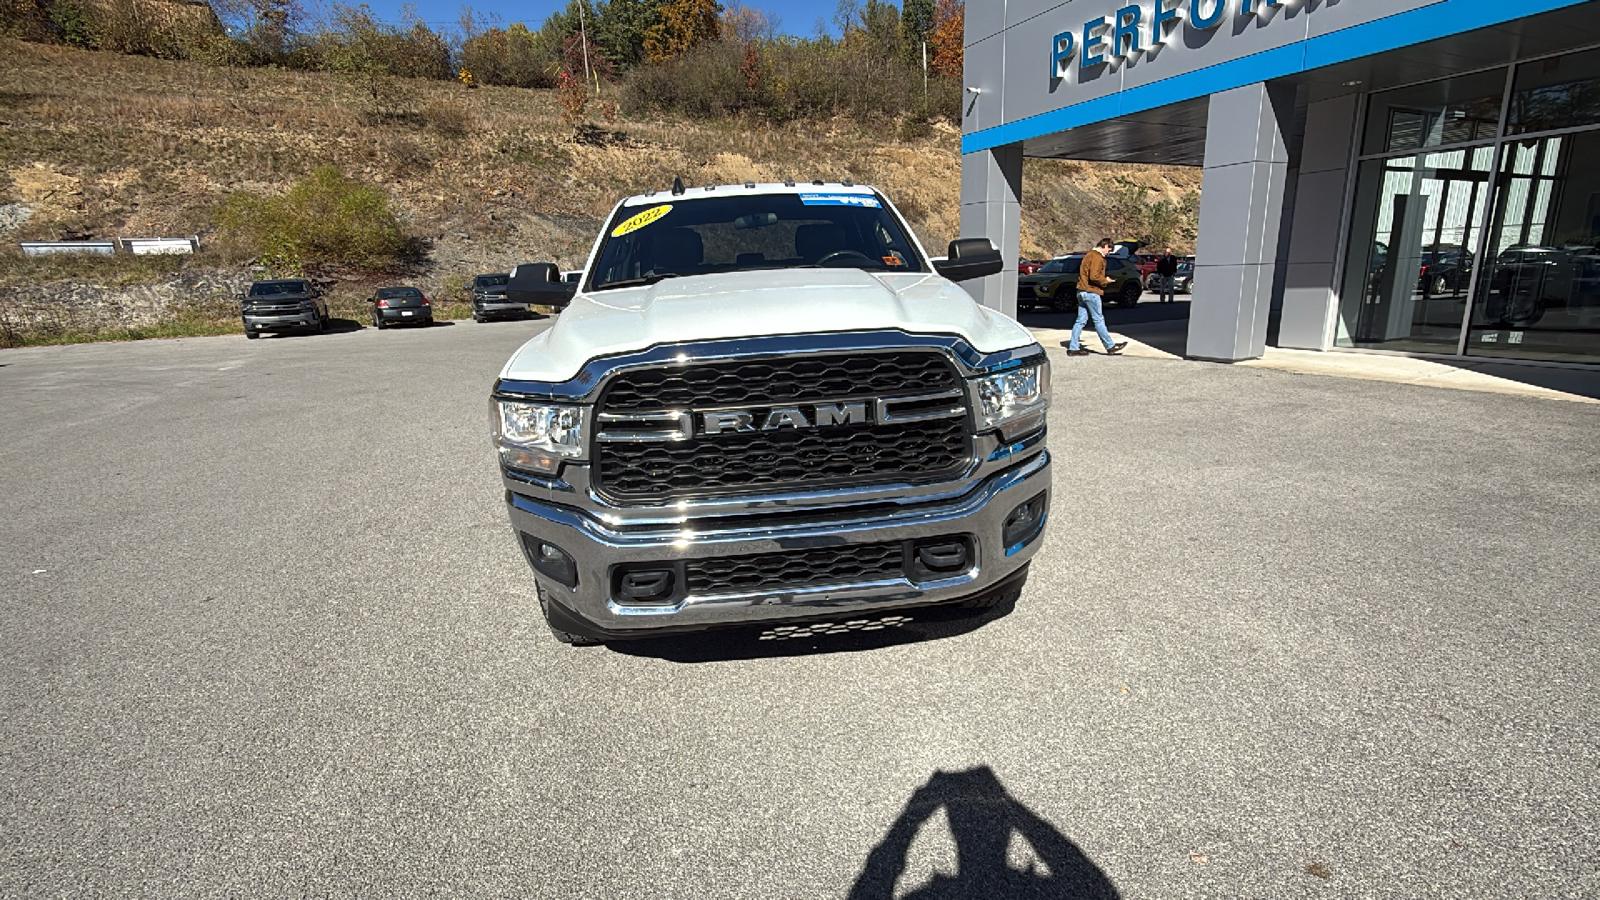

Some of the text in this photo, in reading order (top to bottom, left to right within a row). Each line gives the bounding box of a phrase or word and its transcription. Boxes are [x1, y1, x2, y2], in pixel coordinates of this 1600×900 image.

[1052, 0, 1277, 78] PERFO
[623, 208, 661, 231] 2022
[703, 402, 865, 434] RAM
